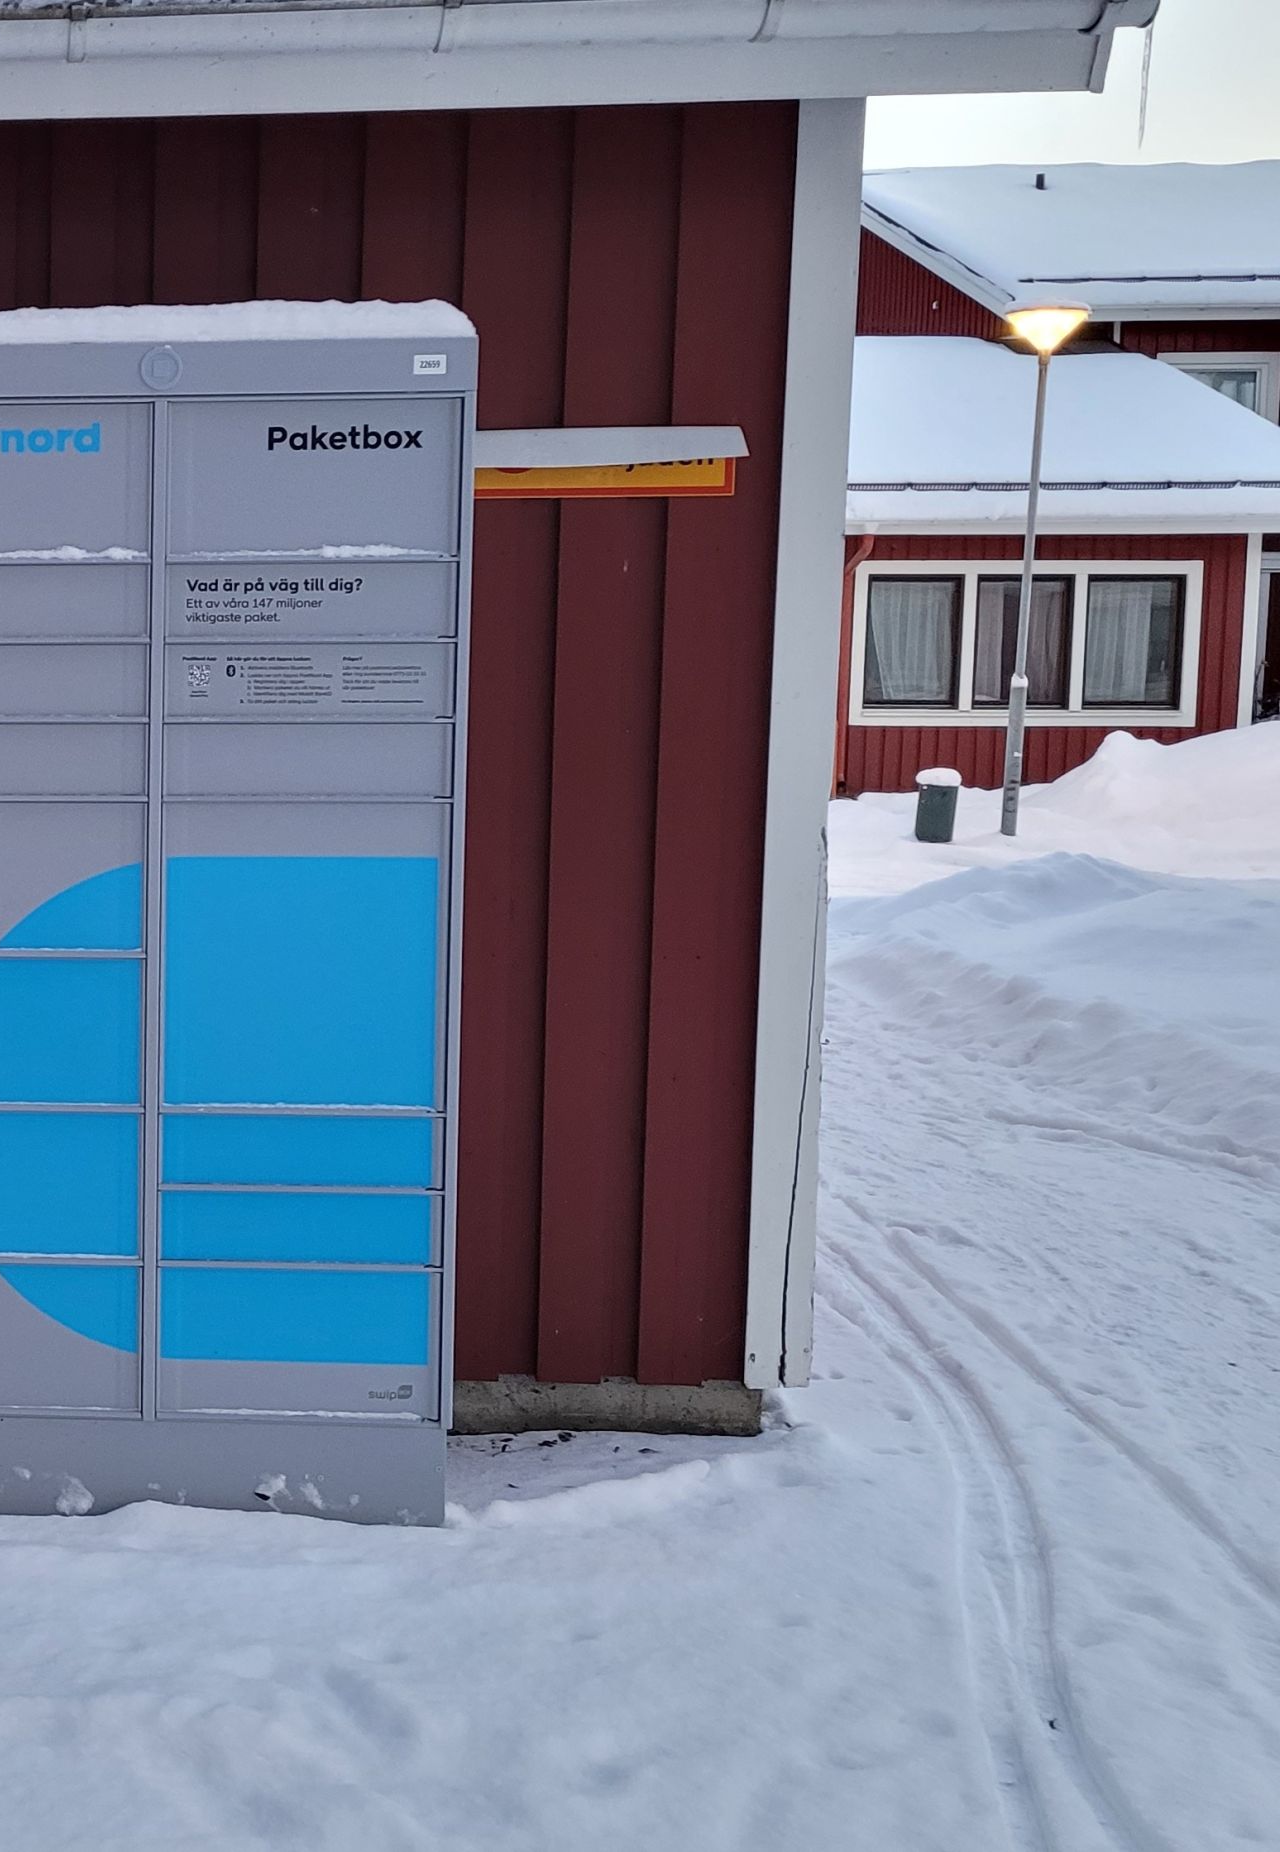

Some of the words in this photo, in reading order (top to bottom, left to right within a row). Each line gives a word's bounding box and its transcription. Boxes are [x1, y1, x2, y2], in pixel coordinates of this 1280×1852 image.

[267, 424, 424, 451] Paketbox
[187, 579, 218, 591] Vad
[223, 579, 240, 591] är
[244, 577, 264, 594] på
[269, 579, 299, 594] väg
[303, 578, 324, 591] till
[328, 578, 362, 593] dig?
[186, 598, 202, 608] Ett
[205, 600, 220, 608] av
[223, 598, 248, 608] våra
[252, 598, 273, 608] 147
[276, 598, 322, 609] miljoner
[186, 613, 241, 624] viktigaste
[245, 612, 280, 624] paket.
[368, 1389, 397, 1401] swip
